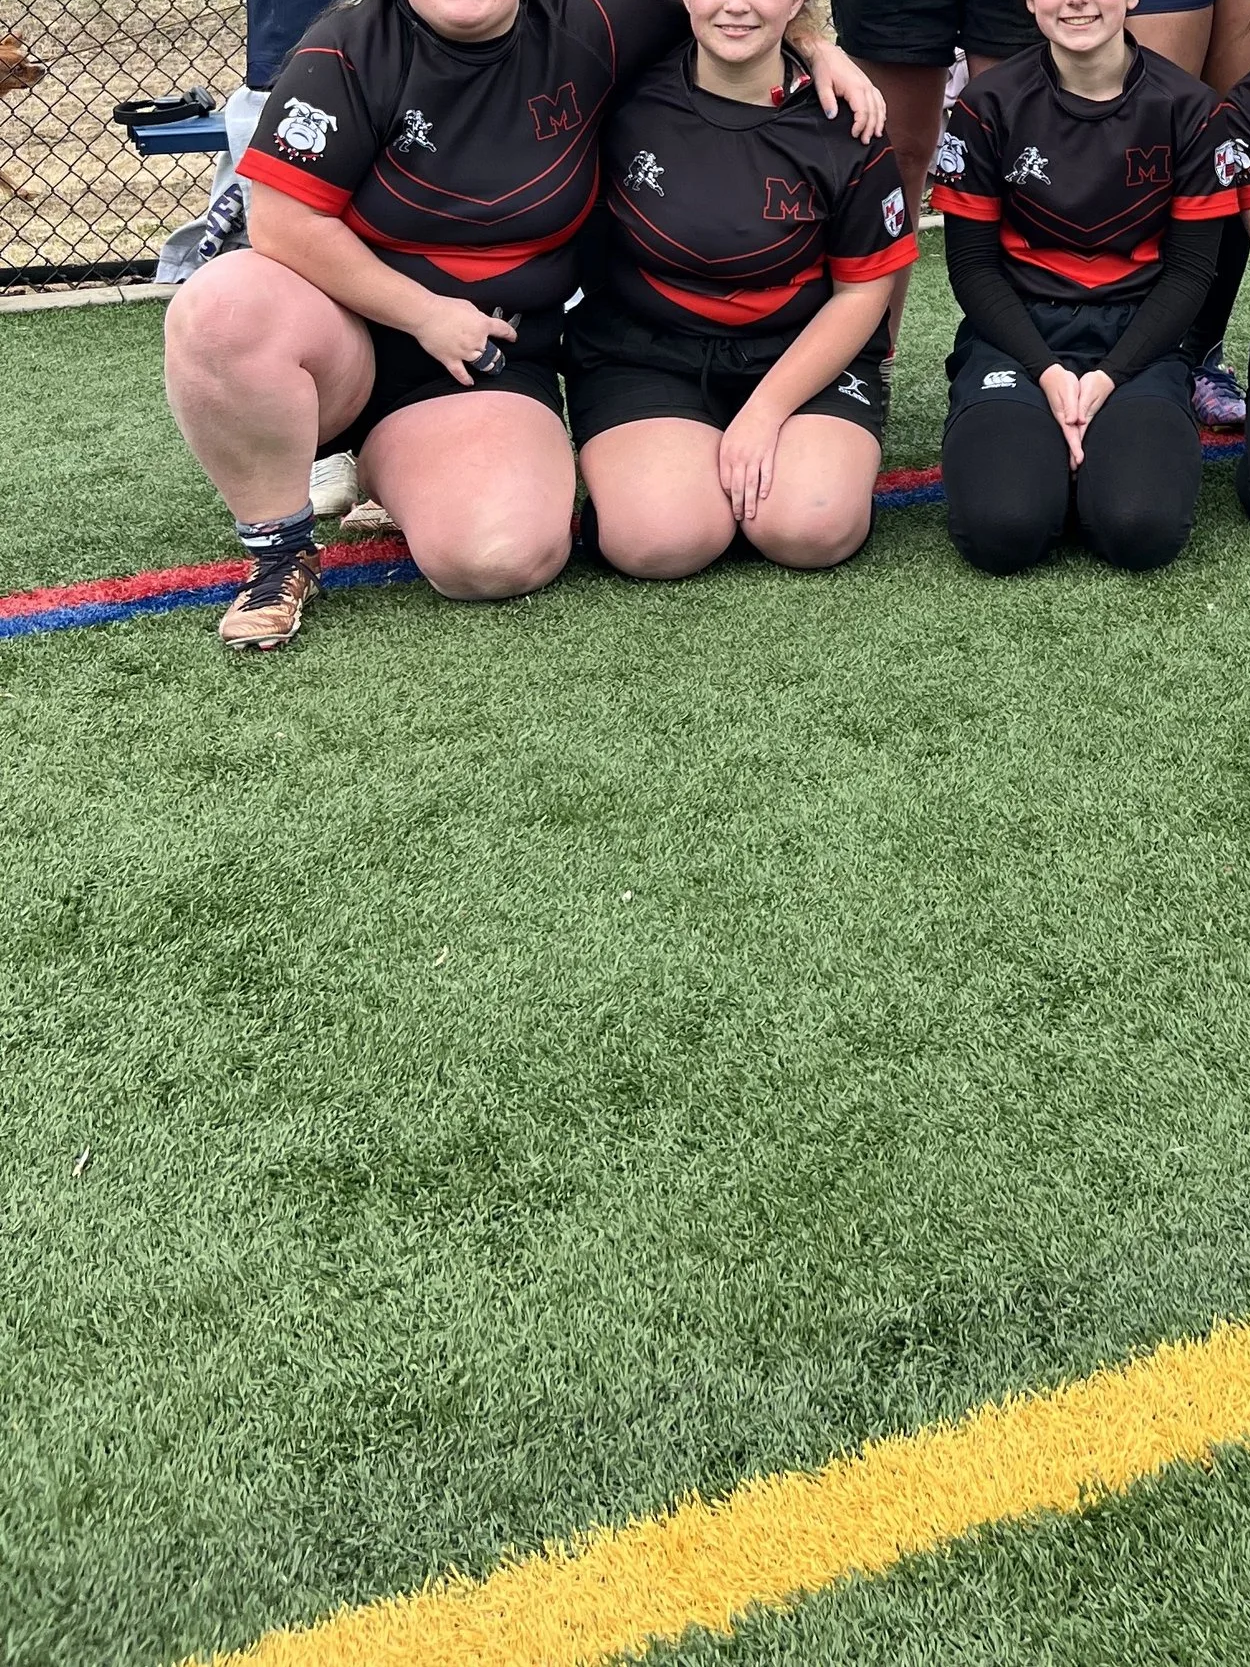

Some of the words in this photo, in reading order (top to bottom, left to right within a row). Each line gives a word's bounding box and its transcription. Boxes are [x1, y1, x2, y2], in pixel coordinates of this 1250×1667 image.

[528, 81, 583, 141] M
[1125, 145, 1171, 187] M
[763, 177, 816, 221] M
